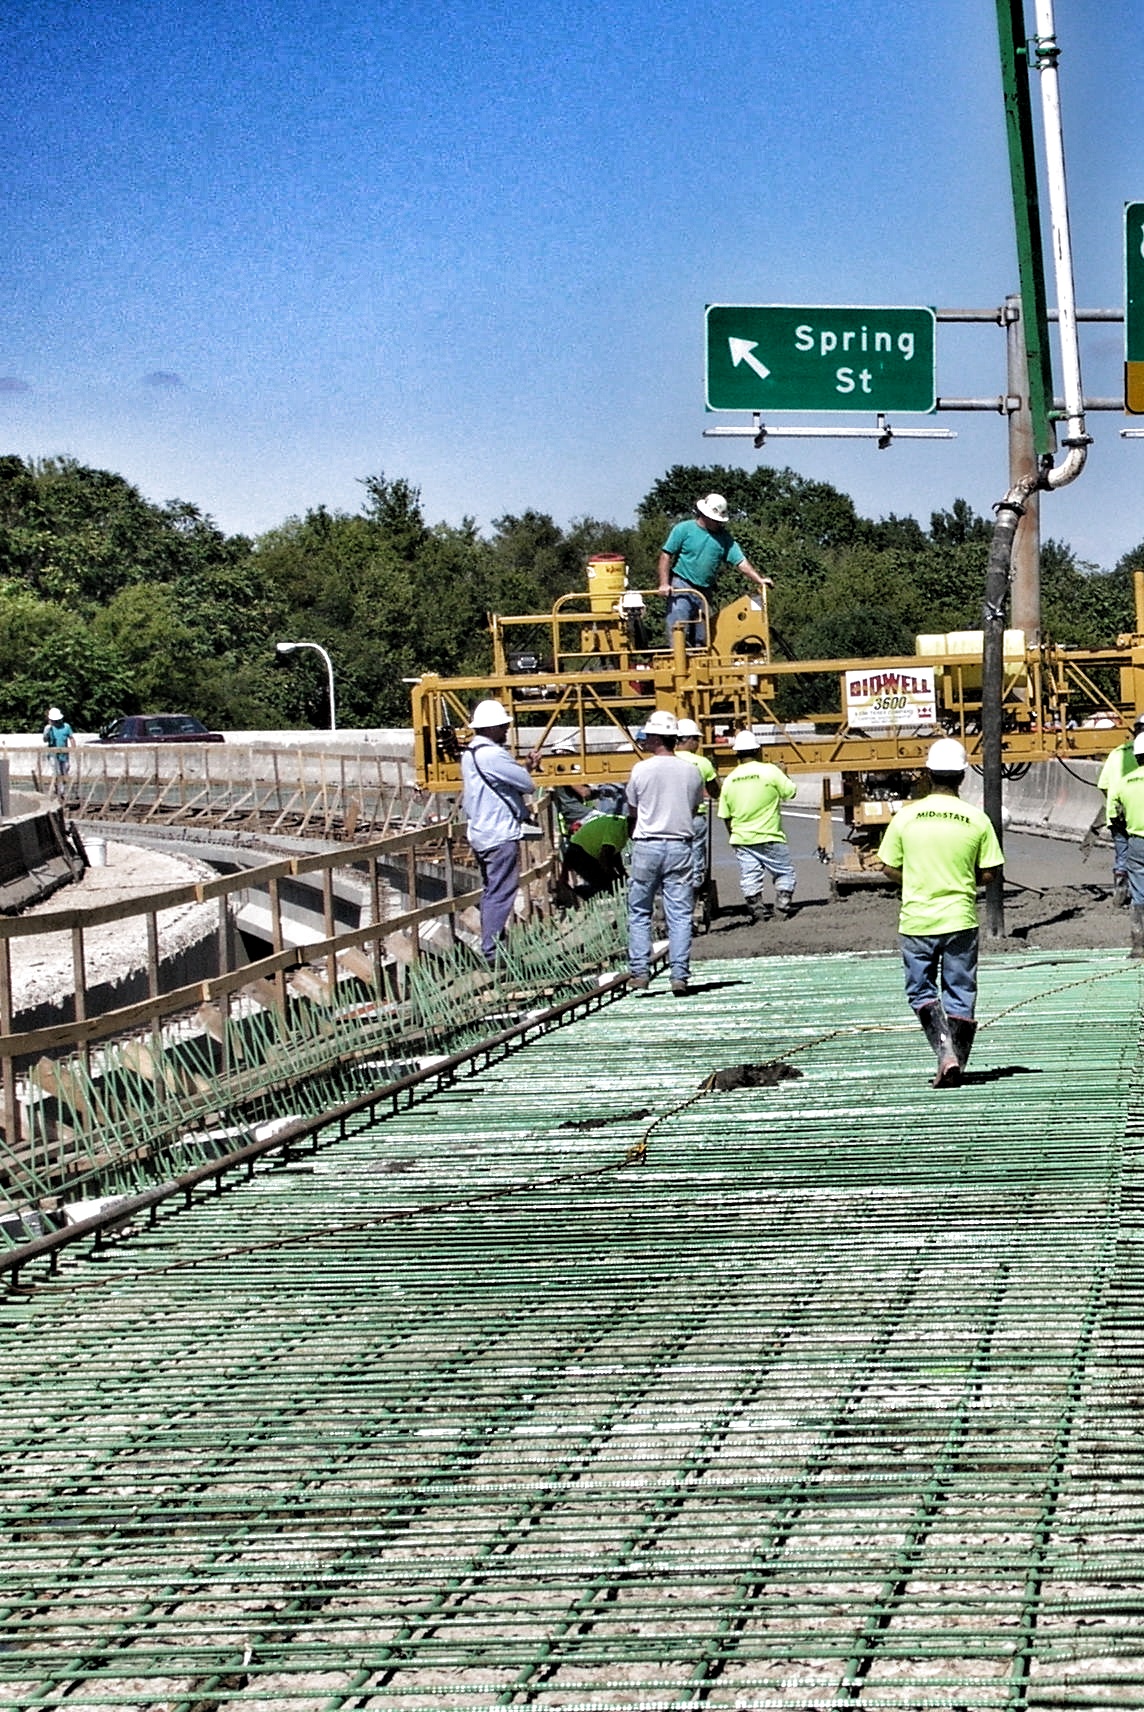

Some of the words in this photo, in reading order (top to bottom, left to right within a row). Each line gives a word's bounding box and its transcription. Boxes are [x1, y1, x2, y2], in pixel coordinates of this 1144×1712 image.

[794, 324, 915, 361] Spring
[835, 367, 873, 394] St
[873, 696, 907, 710] 3600
